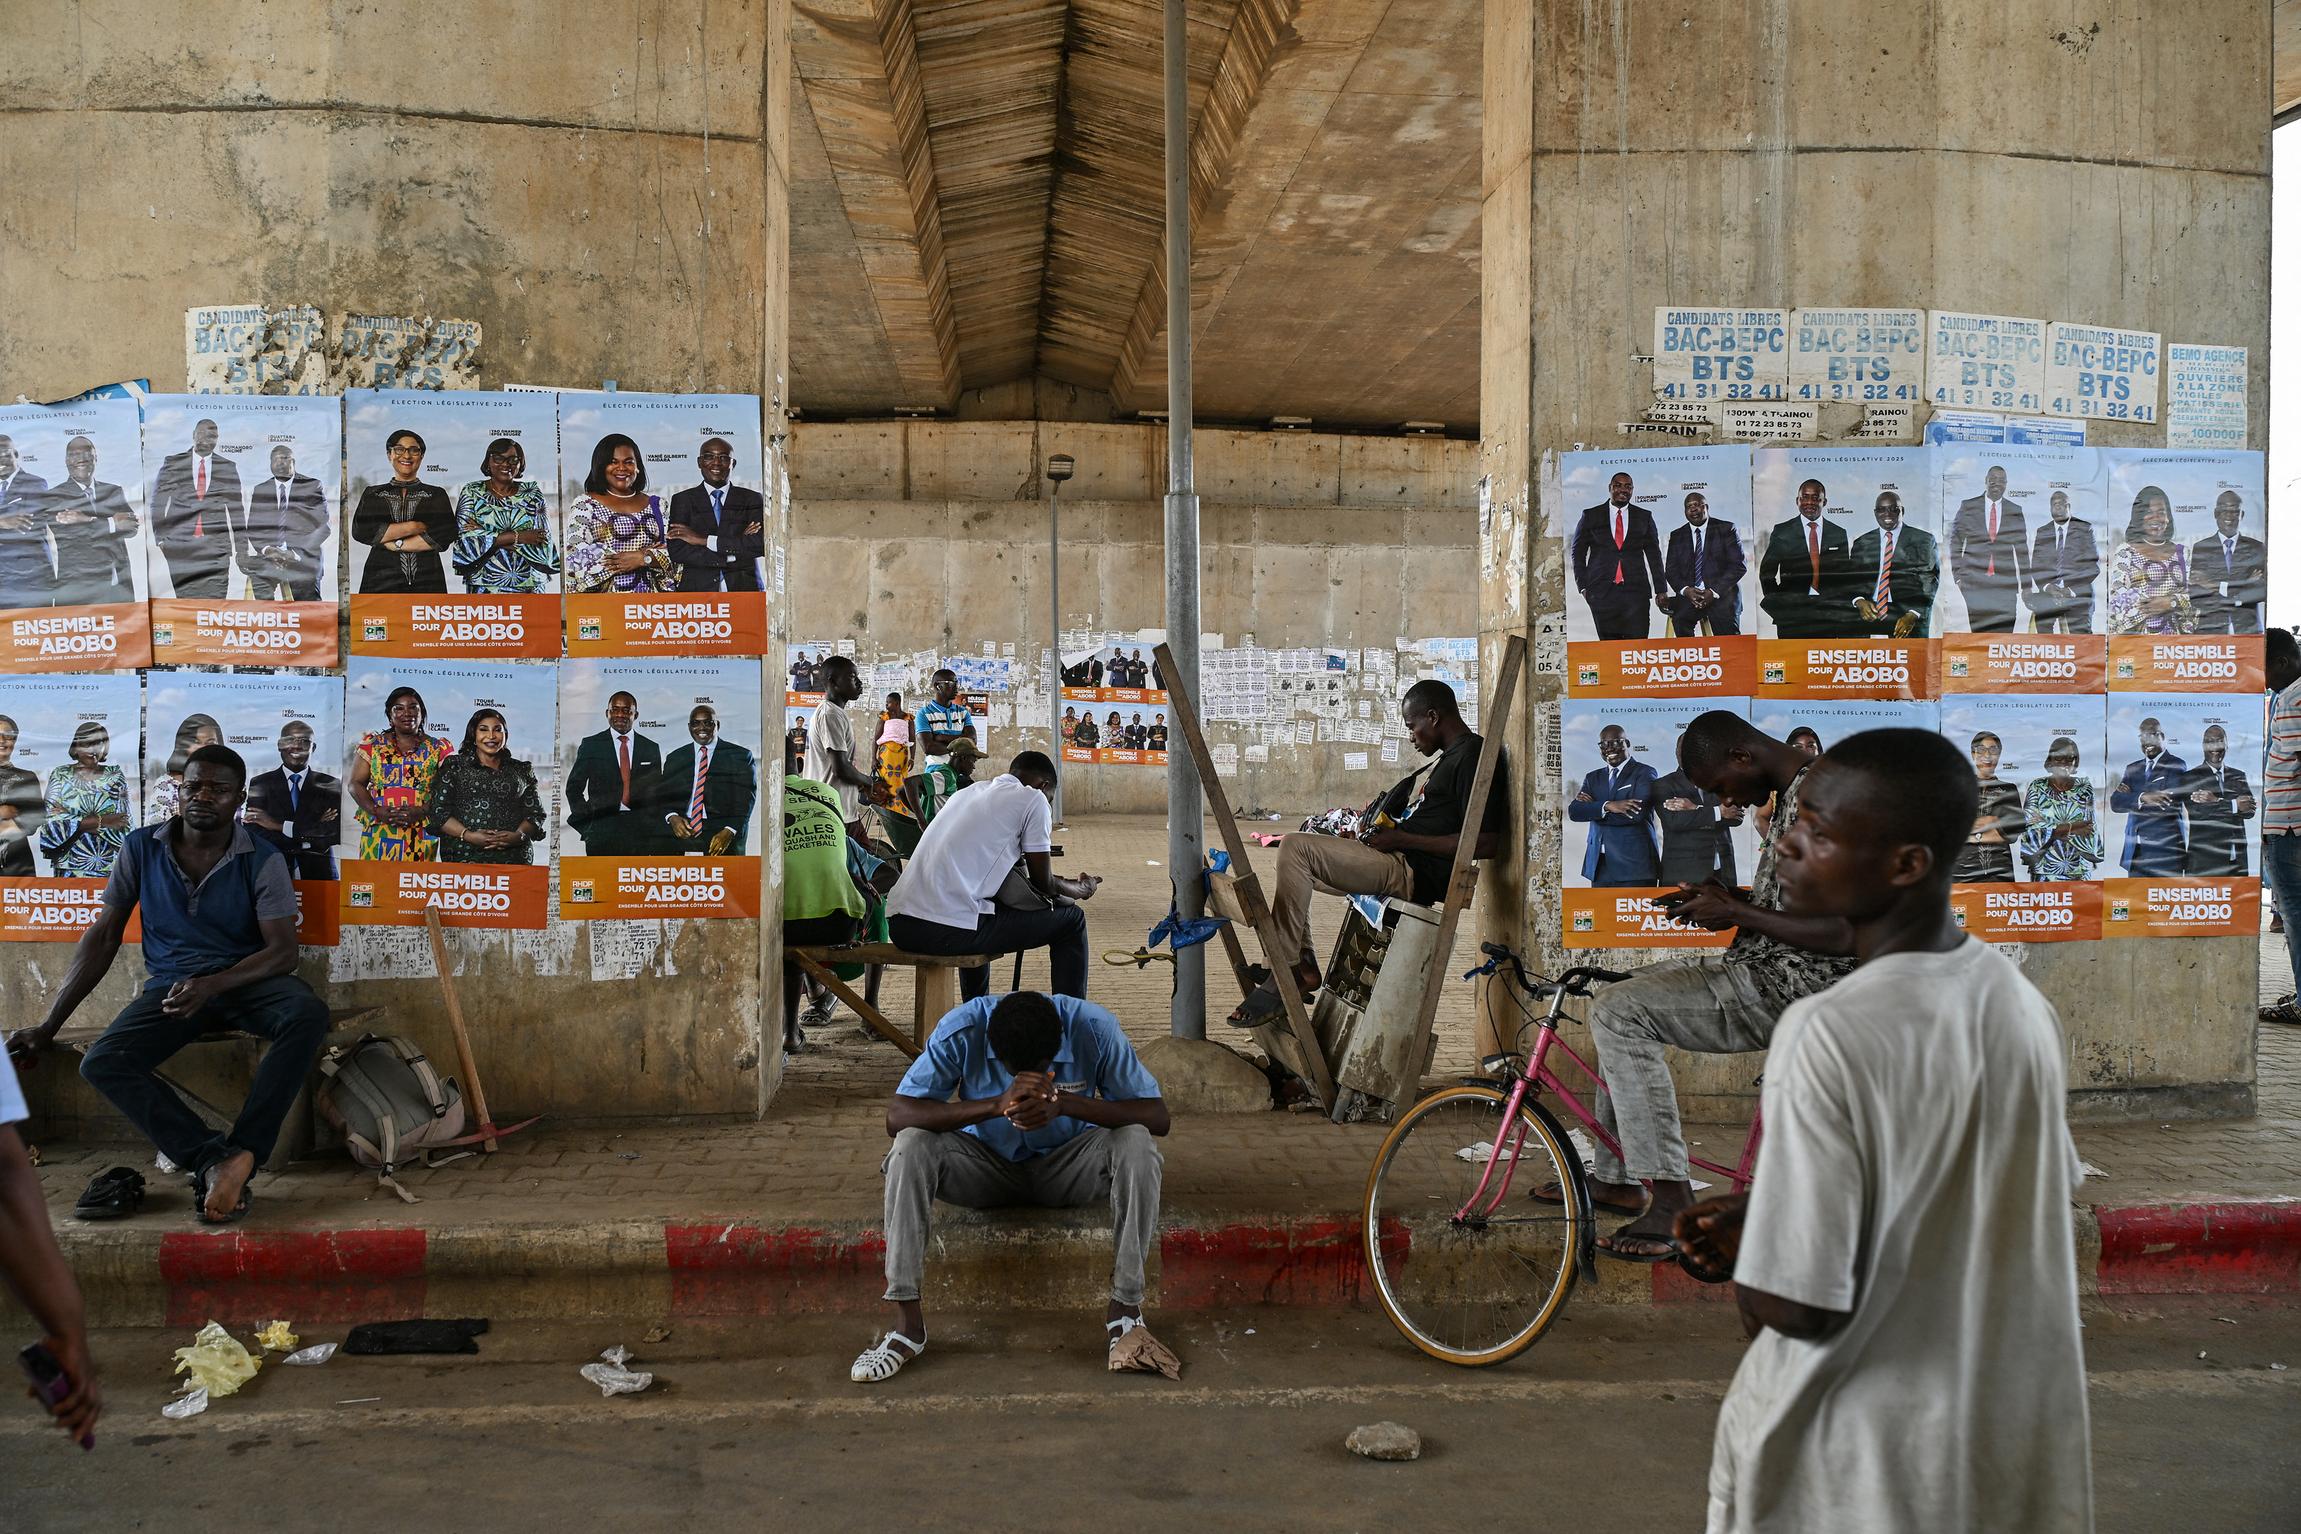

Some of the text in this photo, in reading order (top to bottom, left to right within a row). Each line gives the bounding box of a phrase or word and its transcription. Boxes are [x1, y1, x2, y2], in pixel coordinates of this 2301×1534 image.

[1667, 312, 1781, 326] CANDIDATS LIBRES
[1803, 313, 1917, 326] CANDIDATS LIBRES
[1940, 316, 2039, 336] CANDIDATS LIBRES
[1664, 326, 1784, 352] BAC-BEPC
[1799, 328, 1920, 353] BAC-BEPC
[2058, 327, 2154, 349] CANDIDATS LIBRES
[1936, 331, 2041, 363] BAC-BEPC
[2172, 348, 2201, 360] BEMO
[2055, 341, 2156, 375] BAC-BEPC
[1693, 355, 1754, 380] BTS
[1828, 356, 1890, 381] BTS
[1961, 361, 2016, 388] BTS
[1663, 383, 1685, 398] 41
[1727, 383, 1752, 399] 32
[1759, 384, 1781, 399] 41
[1799, 384, 1821, 399] 41
[1863, 384, 1888, 399] 32
[1895, 384, 1917, 400] 41
[2079, 371, 2130, 401] BTS
[2177, 382, 2184, 390] A
[2189, 382, 2204, 390] LA
[1936, 387, 1955, 403] 41
[1992, 391, 2013, 407] 32
[2019, 393, 2038, 409] 41
[2052, 397, 2071, 412] 41
[2107, 402, 2127, 418] 32
[2133, 405, 2152, 420] 41
[197, 611, 300, 627] ENSEMBLE
[412, 605, 522, 620] ENSEMBLE
[624, 603, 730, 619] ENSEMBLE
[12, 615, 115, 635] ENSEMBLE
[412, 623, 524, 640] POUR ABOBO
[651, 621, 732, 638] ABOBO
[14, 634, 117, 654] POUR ABOBO
[223, 630, 302, 648] ABOBO
[1621, 647, 1721, 665] ENSEMBLE
[1807, 649, 1908, 664] ENSEMBLE
[1988, 644, 2075, 659] ENSEMBLE
[2153, 646, 2236, 659] ENSEMBLE
[1538, 662, 1552, 671] 05
[1622, 664, 1722, 682] POUR ABOBO
[2010, 661, 2076, 677] ABOBO
[2174, 662, 2237, 677] ABOBO
[1832, 667, 1909, 683] ABOBO
[785, 835, 817, 846] QUASH
[399, 872, 510, 891] ENSEMBLE
[618, 867, 724, 882] ENSEMBLE
[3, 888, 104, 904] ENSEMBLE
[399, 891, 510, 910] POUR ABOBO
[618, 885, 725, 902] POUR ABOBO
[1986, 892, 2072, 908] ENSEMBLE
[2148, 887, 2231, 902] ENSEMBLE
[4, 906, 30, 914] POUR
[2007, 909, 2073, 926] ABOBO
[2169, 904, 2232, 919] ABOBO
[634, 942, 644, 950] 72
